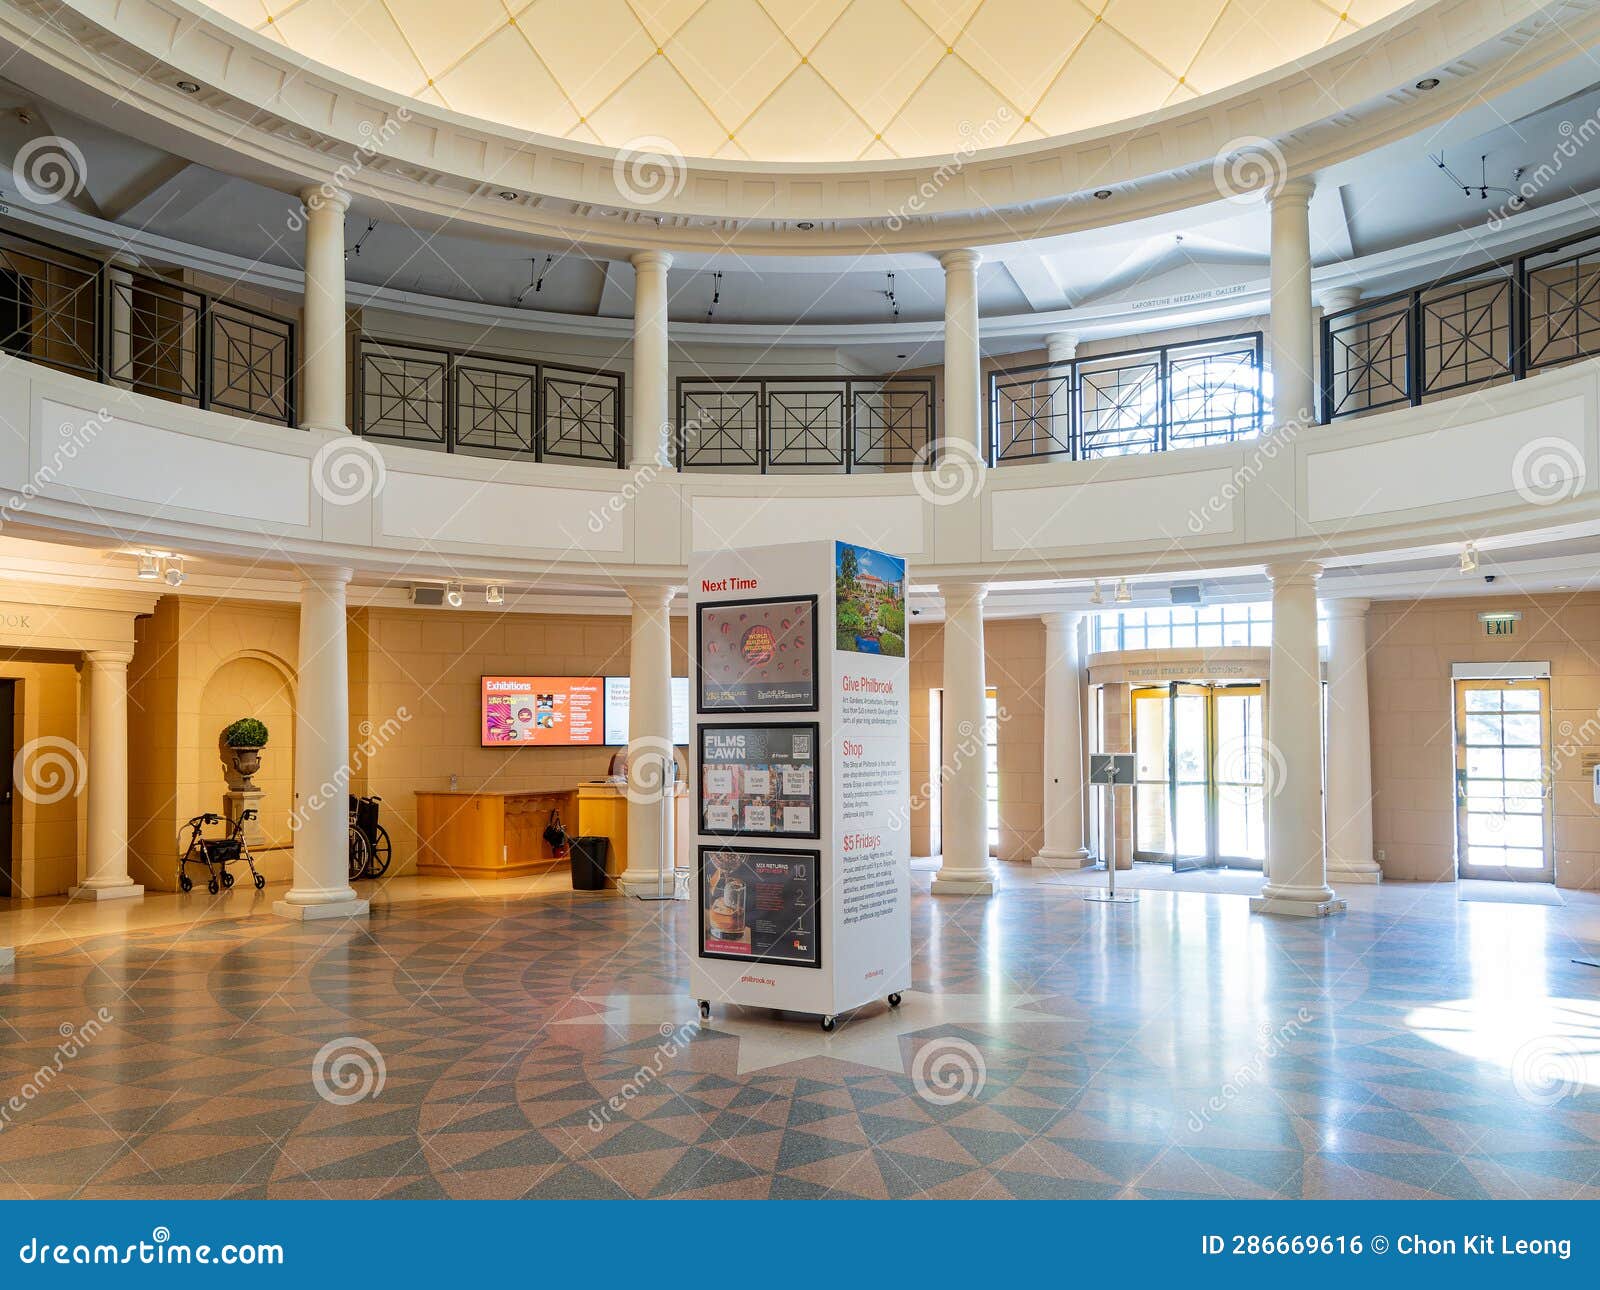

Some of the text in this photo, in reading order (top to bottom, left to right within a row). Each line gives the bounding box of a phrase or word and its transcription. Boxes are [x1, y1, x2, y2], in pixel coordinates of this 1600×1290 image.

[1215, 285, 1246, 296] GALLERY
[702, 578, 757, 593] Next Time
[1486, 619, 1515, 635] EXIT
[486, 681, 531, 691] Exhibitions
[842, 675, 893, 694] Give Philbrook
[705, 736, 745, 747] FILMS
[705, 748, 746, 759] LAWN
[843, 740, 863, 758] Shop
[844, 833, 881, 852] $5 Fridays
[741, 976, 776, 987] philbrook.org
